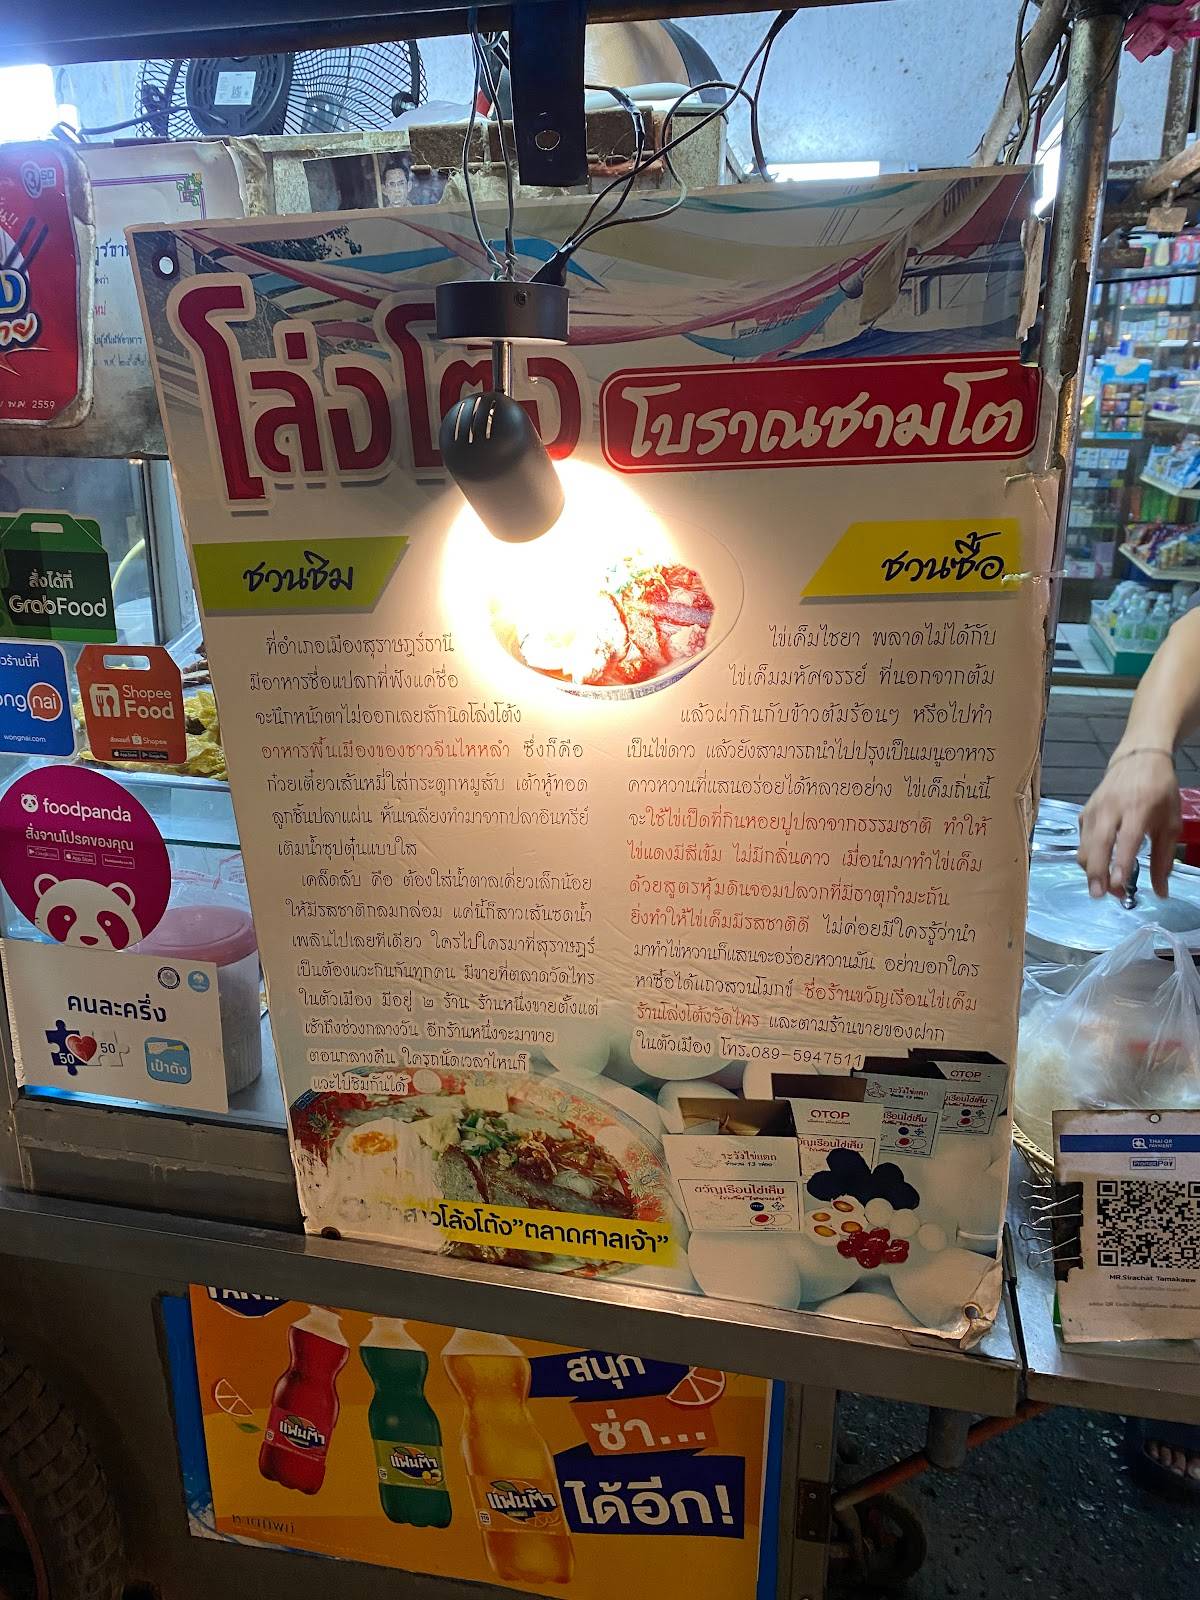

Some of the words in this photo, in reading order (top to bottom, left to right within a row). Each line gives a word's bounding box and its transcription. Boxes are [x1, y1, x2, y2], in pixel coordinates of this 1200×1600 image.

[31, 400, 56, 410] 2559
[621, 367, 1024, 458] โบราณชามโต
[880, 531, 1005, 583] ชวนซื้อ
[28, 569, 74, 590] สั่งได้ที่
[243, 550, 354, 593] ชวนชิม
[8, 594, 107, 618] GrabFood
[768, 623, 860, 647] ไข่เค็มไชยา
[872, 621, 997, 647] พลาดไม่ได้กับ
[250, 664, 459, 692] มีอาหารชื่อแปลกที่ฟังแค่ชื่อ
[728, 662, 868, 686] ไข่เค็มมหัศจรรย์
[879, 658, 996, 685] ที่นอกจากต้ม
[122, 684, 172, 702] Shopee
[124, 699, 175, 720] Food
[680, 702, 900, 727] แล้วผ่ากินกับข้าวต้มร้อนๆ
[913, 700, 993, 724] หรือไปทำ
[261, 736, 511, 759] อาหารพื้นเมืองของชาวจีนไหหลำ
[523, 734, 584, 758] ซึ่งก็คือ
[626, 737, 696, 758] เป็นไข่ดาว
[705, 737, 996, 767] แล้วยังสามารถนำไปปรุงเป็นเมนูอาหาร
[516, 772, 588, 797] เต้าหู้ทอด
[628, 769, 893, 797] คาวหวานที่แสนอร่อยได้หลายอย่าง
[903, 774, 996, 800] ไข่เค็มถิ่นนี้
[43, 797, 132, 823] foodpanda
[271, 803, 373, 830] ลูกชิ้นปลาแผ่น
[25, 822, 134, 853] สั่งจานโปรดของคุณ
[943, 813, 993, 837] ทำให้
[626, 839, 723, 862] ไข่แดงมีสีเข้ม
[731, 841, 831, 865] ไม่มีกลิ่นคาว
[842, 843, 984, 873] เมื่อนำมาทำไข่เค็ม
[301, 868, 362, 888] เคล็ดลับ
[371, 869, 394, 888] คือ
[285, 898, 443, 919] ให้มีรสชาติกลมกล่อม
[822, 913, 977, 945] ไม่ค่อยมีใครรู้ว่านำ
[464, 960, 596, 985] มีขายที่ตลาดวัดไทร
[884, 953, 981, 978] อย่าบอกใคร
[635, 968, 794, 998] หาซื้อได้แถวสวนโมกข์
[67, 993, 167, 1023] คนละครึ่ง
[298, 987, 373, 1007] ในตัวเมือง
[381, 989, 413, 1013] มีอยู่
[422, 995, 435, 1008] ๒
[443, 991, 470, 1009] ร้าน
[304, 1017, 419, 1037] เช้าถึงช่วงกลางวัน
[769, 1014, 946, 1042] และตามร้านขายของฝาก
[100, 1042, 116, 1054] 50
[635, 1029, 712, 1055] ในตัวเมือง
[59, 1052, 75, 1065] 50
[308, 1048, 396, 1065] ตอนกลางคืน
[950, 1069, 982, 1077] OTOP
[810, 1109, 851, 1119] OTOP
[566, 1354, 647, 1390] สนุก
[563, 1476, 734, 1525] ได้อีก!
